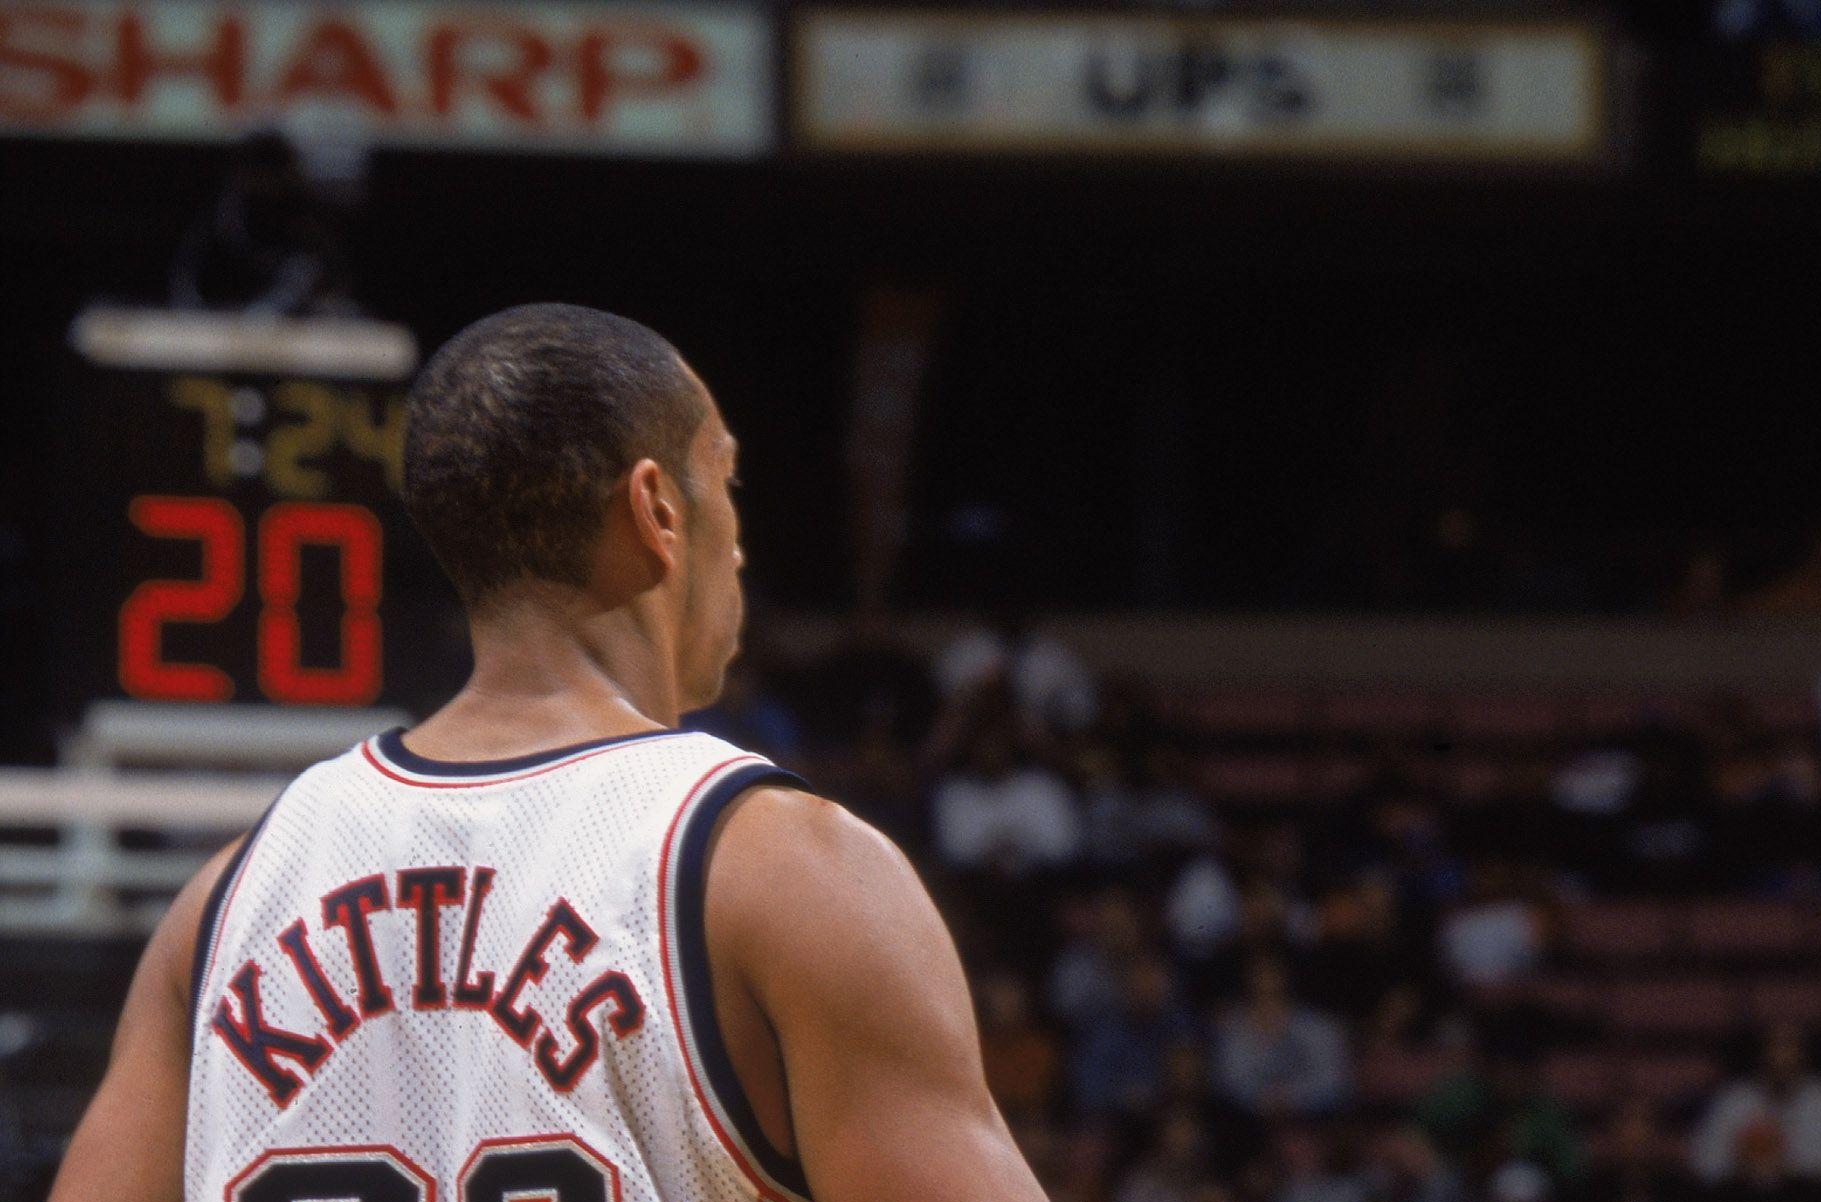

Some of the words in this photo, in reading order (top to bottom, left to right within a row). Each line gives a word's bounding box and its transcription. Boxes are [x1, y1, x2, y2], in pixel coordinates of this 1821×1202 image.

[0, 8, 704, 122] SHARP
[1082, 44, 1314, 120] UPS
[170, 374, 408, 497] 7:24
[117, 493, 384, 706] 20
[213, 867, 646, 1109] KITTLES
